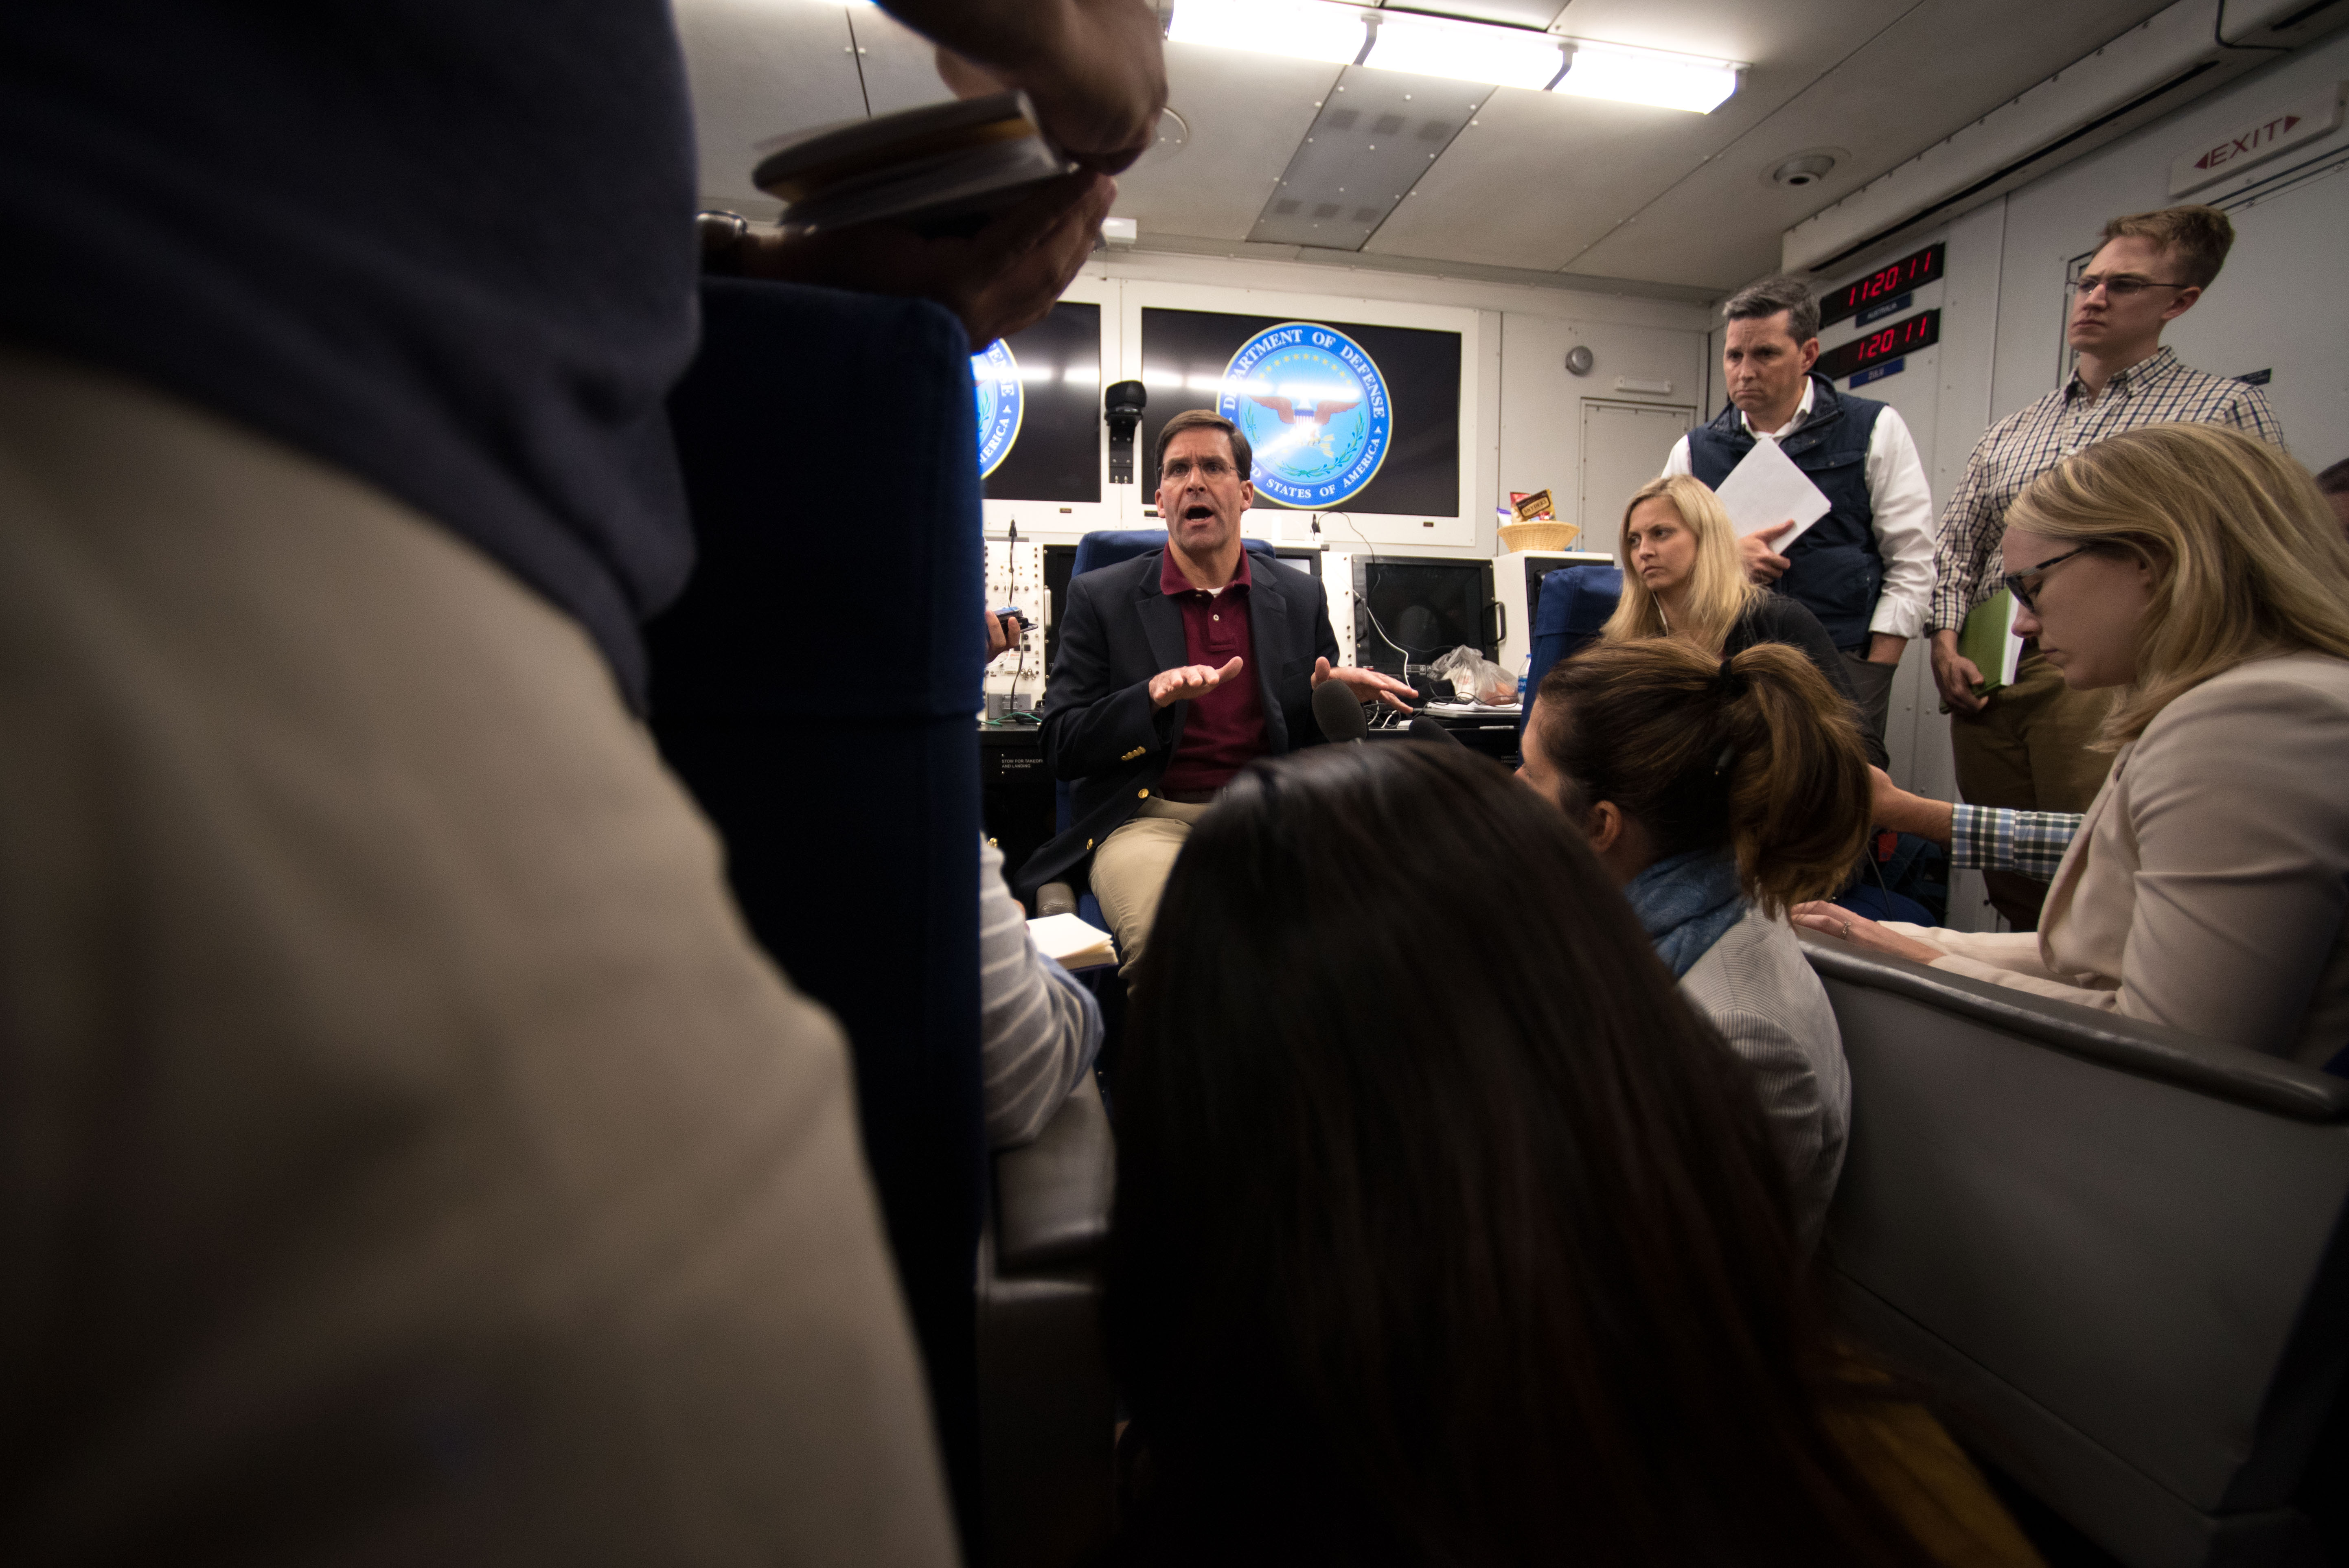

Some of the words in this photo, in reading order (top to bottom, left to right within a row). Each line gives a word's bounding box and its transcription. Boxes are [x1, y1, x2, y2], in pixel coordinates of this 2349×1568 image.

[2209, 117, 2283, 168] EXIT
[1312, 331, 1336, 349] OF
[1340, 344, 1385, 418] DEFENSE
[979, 418, 1009, 464] MERICA
[1266, 478, 1311, 499] STATES
[1319, 484, 1336, 497] OF
[1343, 438, 1380, 488] AMERICA
